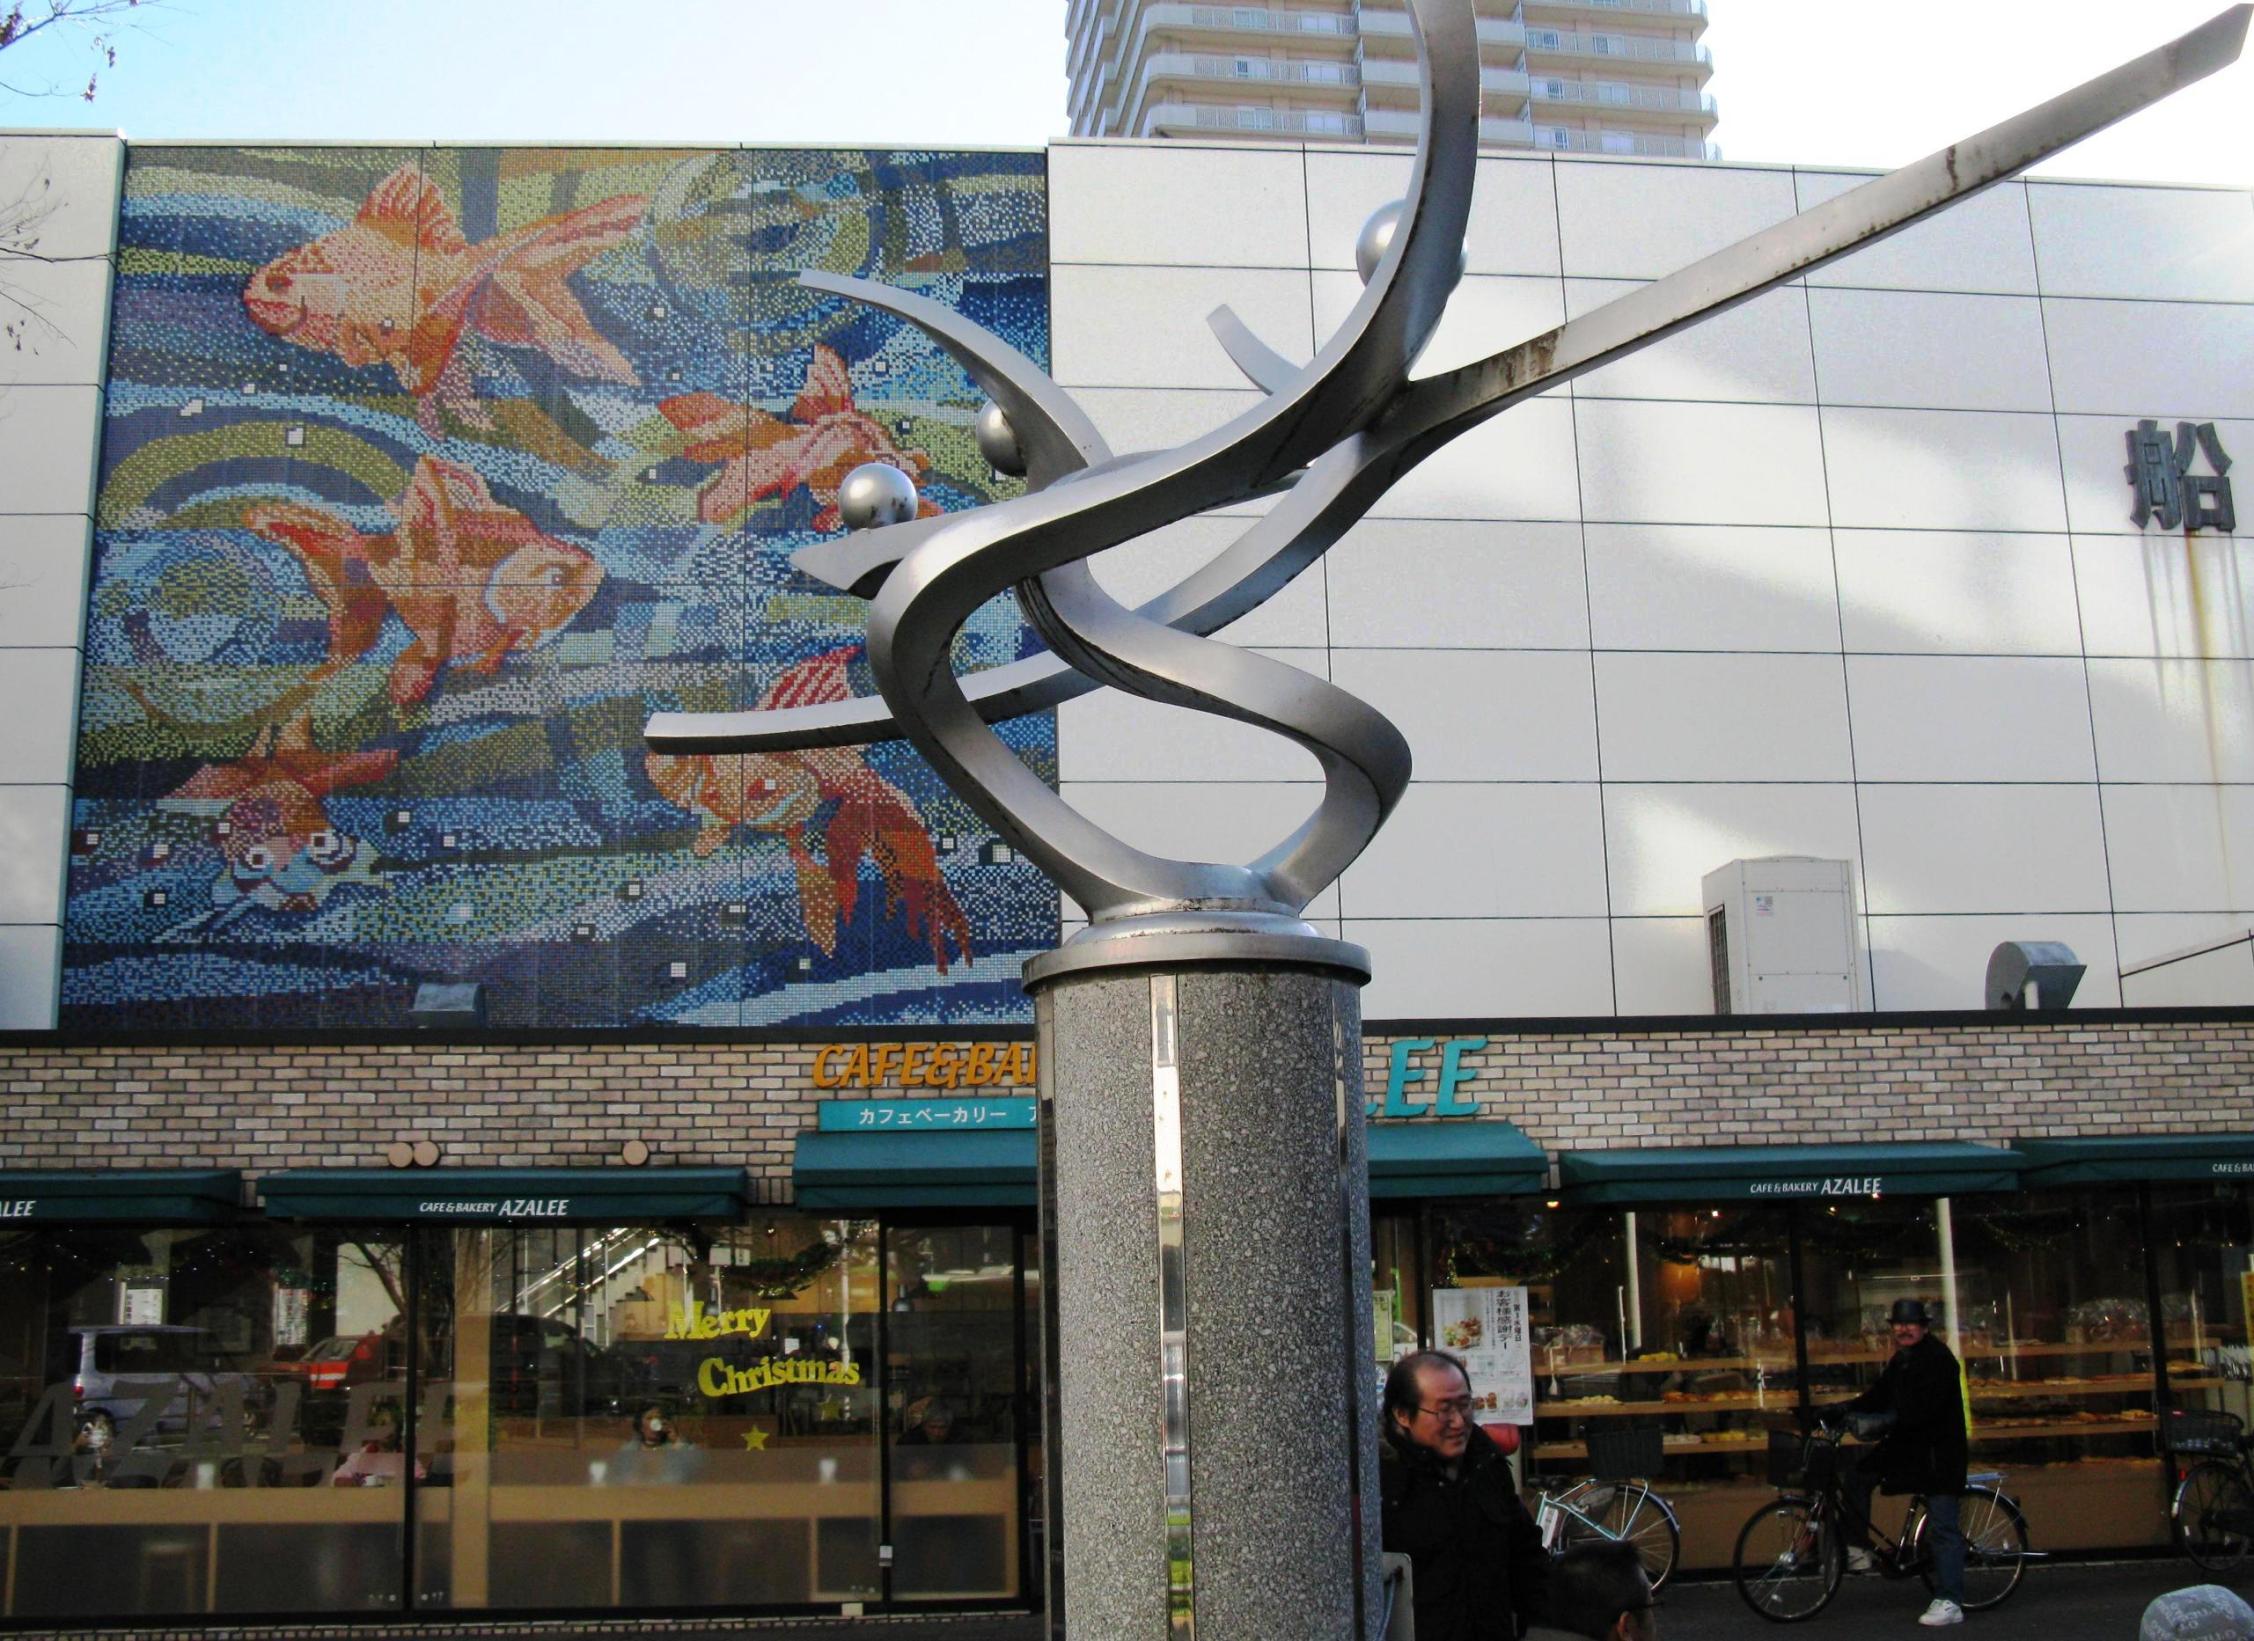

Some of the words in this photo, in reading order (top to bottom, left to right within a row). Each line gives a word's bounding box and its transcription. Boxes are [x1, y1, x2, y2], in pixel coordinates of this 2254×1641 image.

[2124, 419, 2236, 533] 船
[858, 1106, 1007, 1125] カフェベーカリー
[1821, 1177, 1882, 1195] AZALEE
[498, 1199, 570, 1216] AZALEE
[664, 1300, 771, 1339] Merry
[698, 1355, 861, 1398] Christmas
